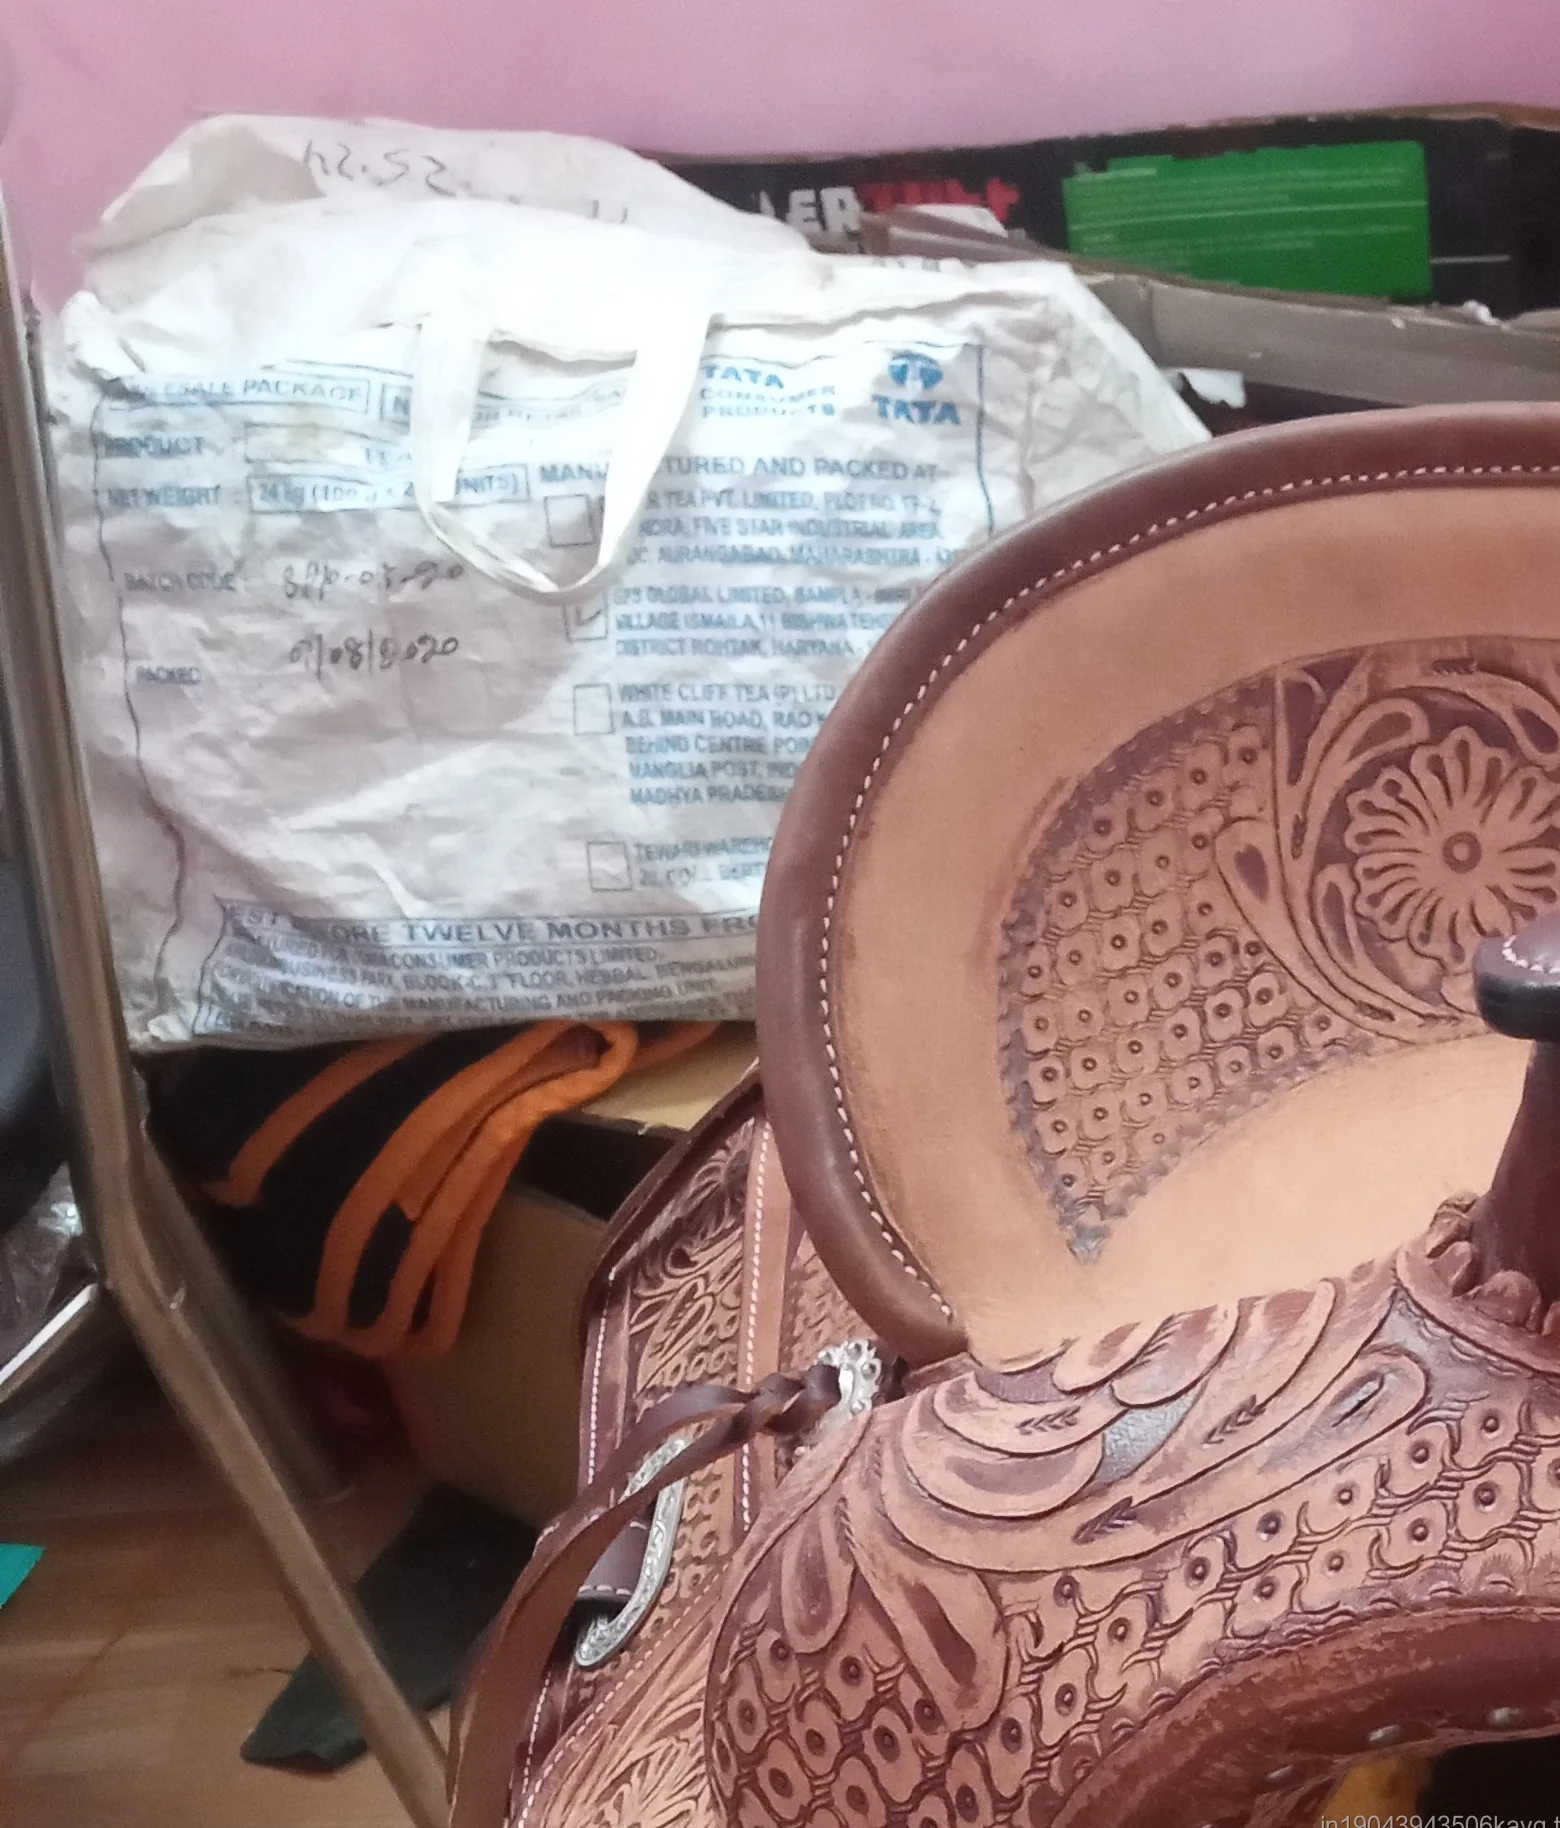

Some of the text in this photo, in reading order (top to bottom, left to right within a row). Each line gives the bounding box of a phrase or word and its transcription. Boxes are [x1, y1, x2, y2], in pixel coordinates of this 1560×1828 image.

[701, 365, 784, 389] TATA
[243, 378, 367, 401] PACKAGE
[872, 393, 961, 425] TATA
[754, 457, 805, 477] AND
[815, 457, 909, 480] PACKED
[731, 684, 770, 703] TEA
[406, 916, 533, 944] TWELVE
[547, 918, 692, 943] MONTHS
